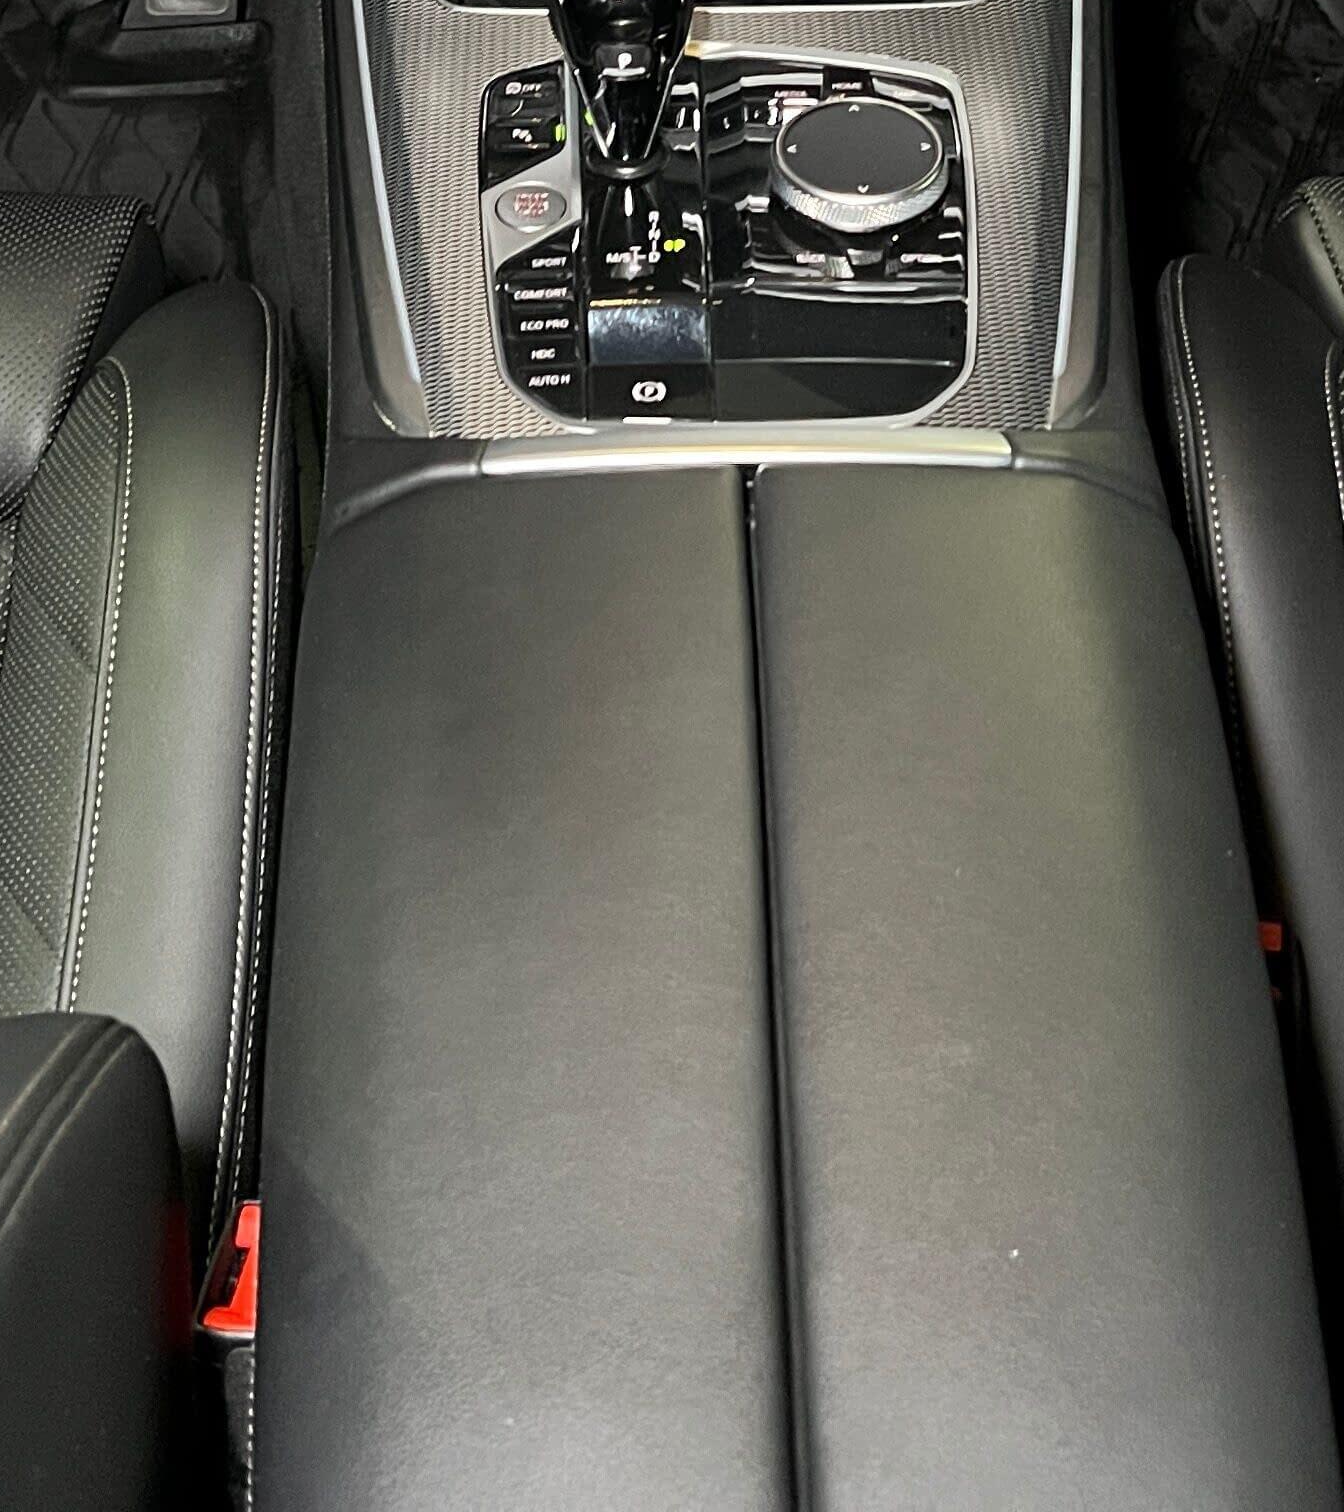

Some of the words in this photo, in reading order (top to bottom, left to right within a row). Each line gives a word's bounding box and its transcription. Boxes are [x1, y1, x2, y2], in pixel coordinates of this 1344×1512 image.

[531, 256, 567, 269] SPORT
[520, 319, 543, 331] ECO
[544, 317, 570, 331] PRO
